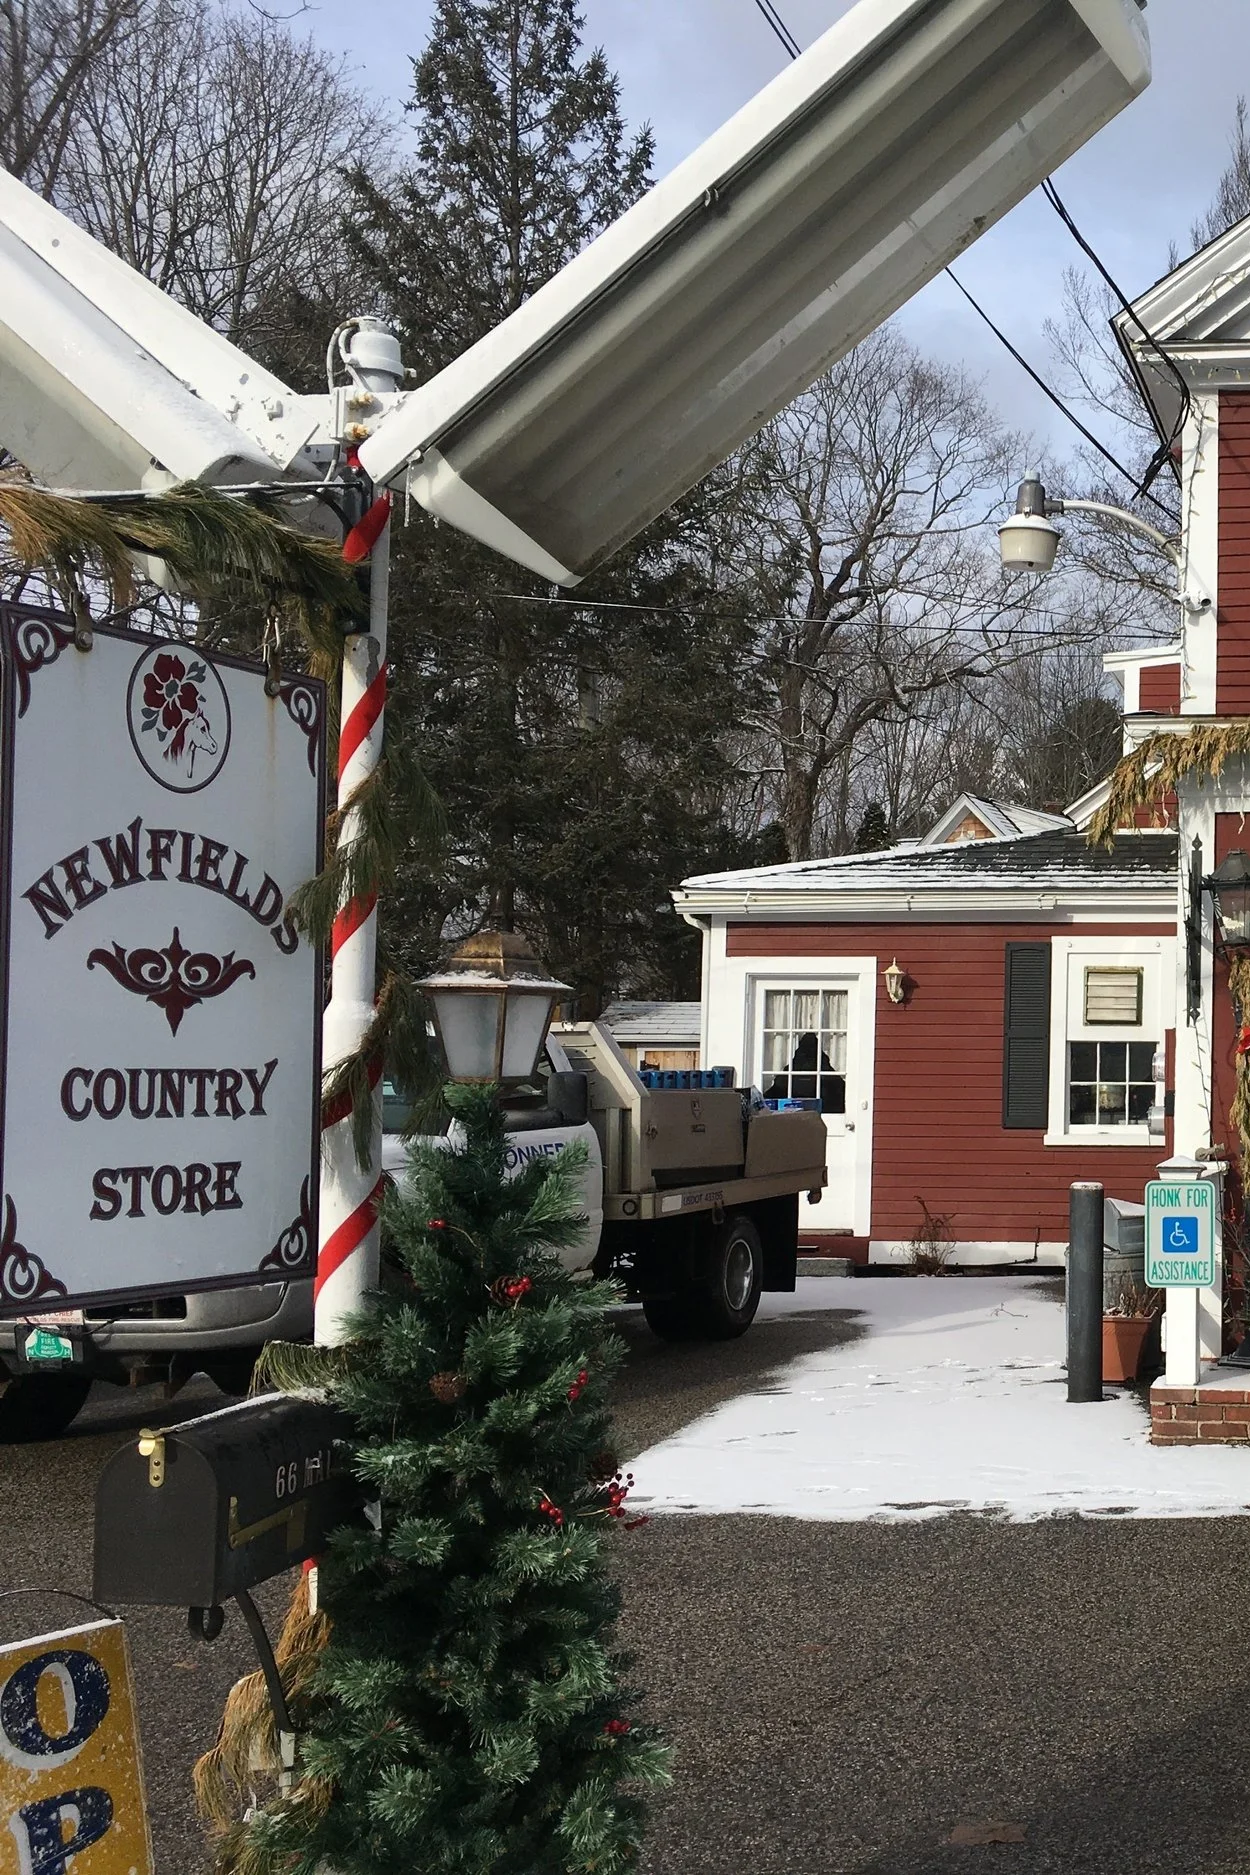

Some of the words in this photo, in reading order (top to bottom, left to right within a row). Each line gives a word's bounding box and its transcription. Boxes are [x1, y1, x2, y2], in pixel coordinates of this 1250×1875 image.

[20, 815, 301, 955] NEWFIELDS
[60, 1057, 279, 1122] COUNTRY
[88, 1160, 243, 1221] STORE
[1151, 1188, 1181, 1208] HONK
[1187, 1188, 1208, 1208] FOR
[1151, 1261, 1209, 1281] ASSISTANCE
[276, 1462, 298, 1498] 66
